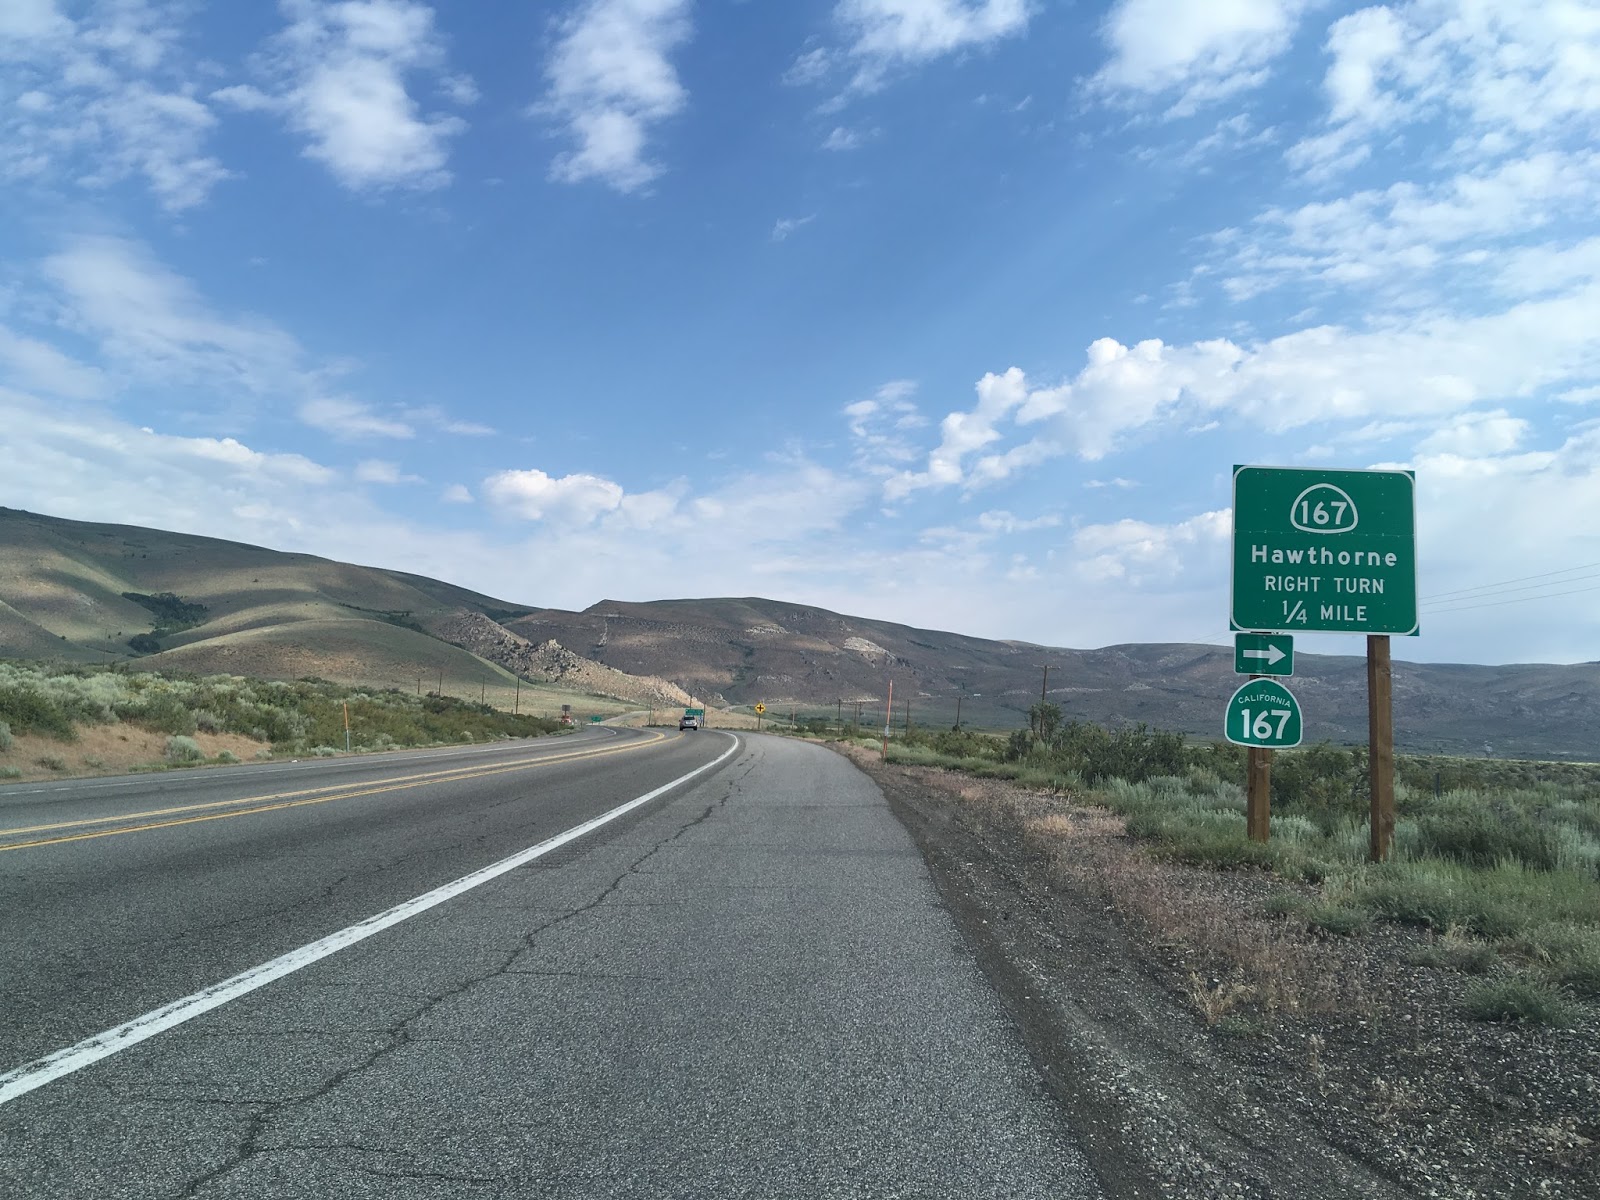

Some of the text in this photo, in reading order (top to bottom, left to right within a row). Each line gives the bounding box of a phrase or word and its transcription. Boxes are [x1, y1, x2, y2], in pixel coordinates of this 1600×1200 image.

[1301, 501, 1347, 525] 167
[1251, 545, 1398, 567] Hawthorne
[1265, 576, 1385, 594] RIGHT TURN
[1282, 600, 1368, 624] 1/4 MILE
[1238, 694, 1291, 707] CALIFORNIA
[1241, 708, 1292, 740] 167
